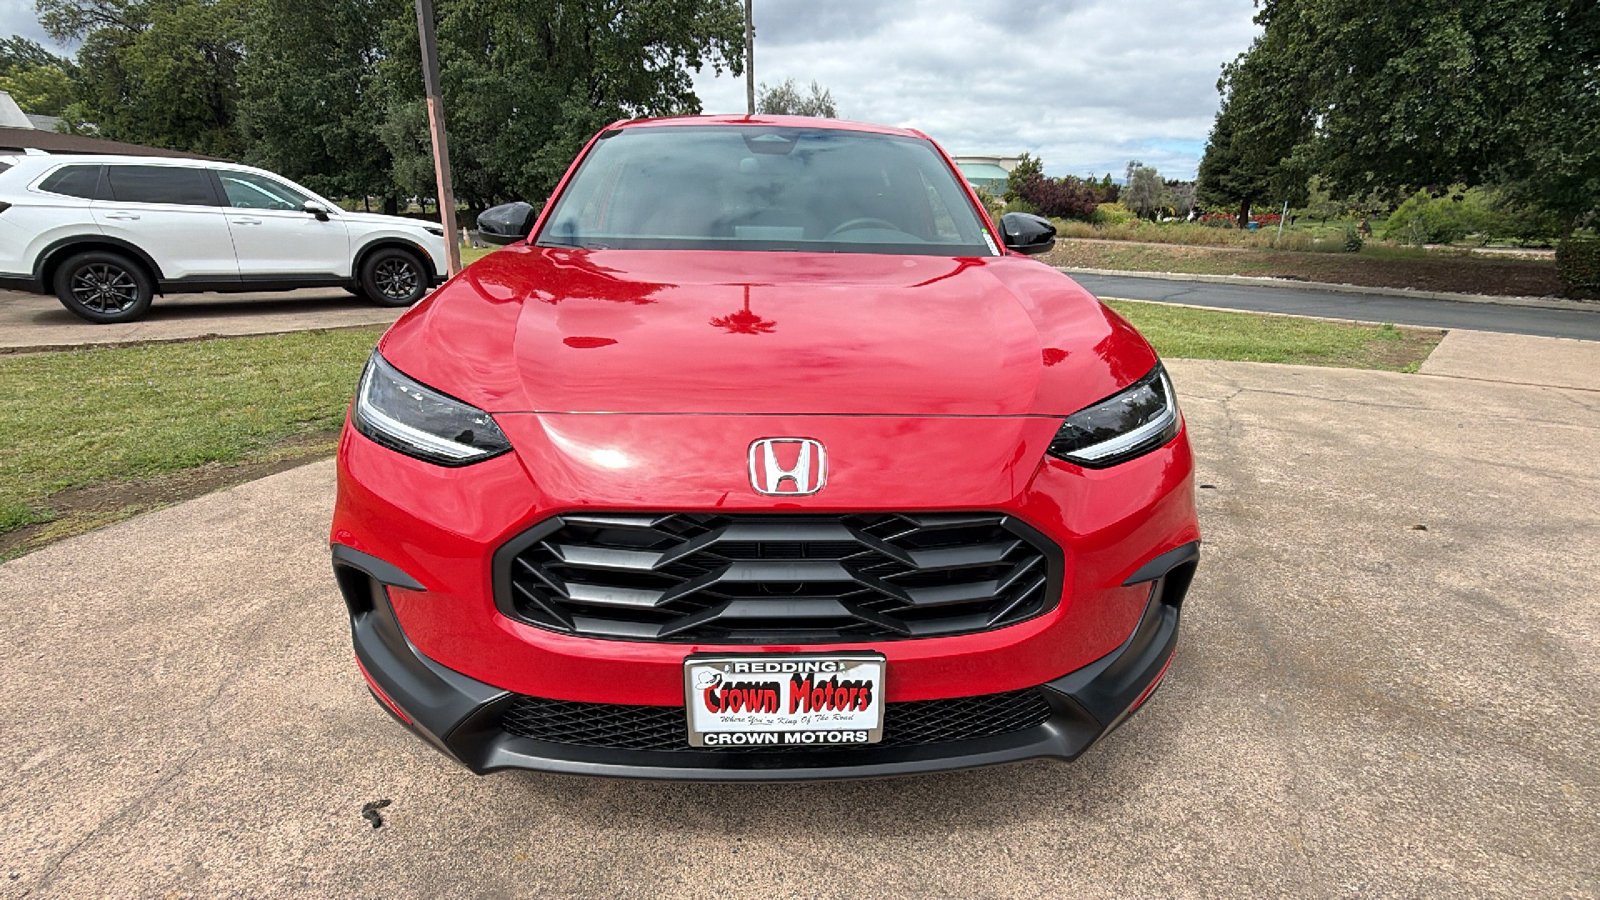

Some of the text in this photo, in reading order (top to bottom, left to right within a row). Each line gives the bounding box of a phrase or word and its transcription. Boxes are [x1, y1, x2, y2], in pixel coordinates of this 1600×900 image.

[734, 662, 837, 673] REDDING
[703, 673, 873, 714] Crown Motors
[720, 713, 855, 726] Where You're King Of The Road
[704, 731, 868, 745] CROWN MOTORS
